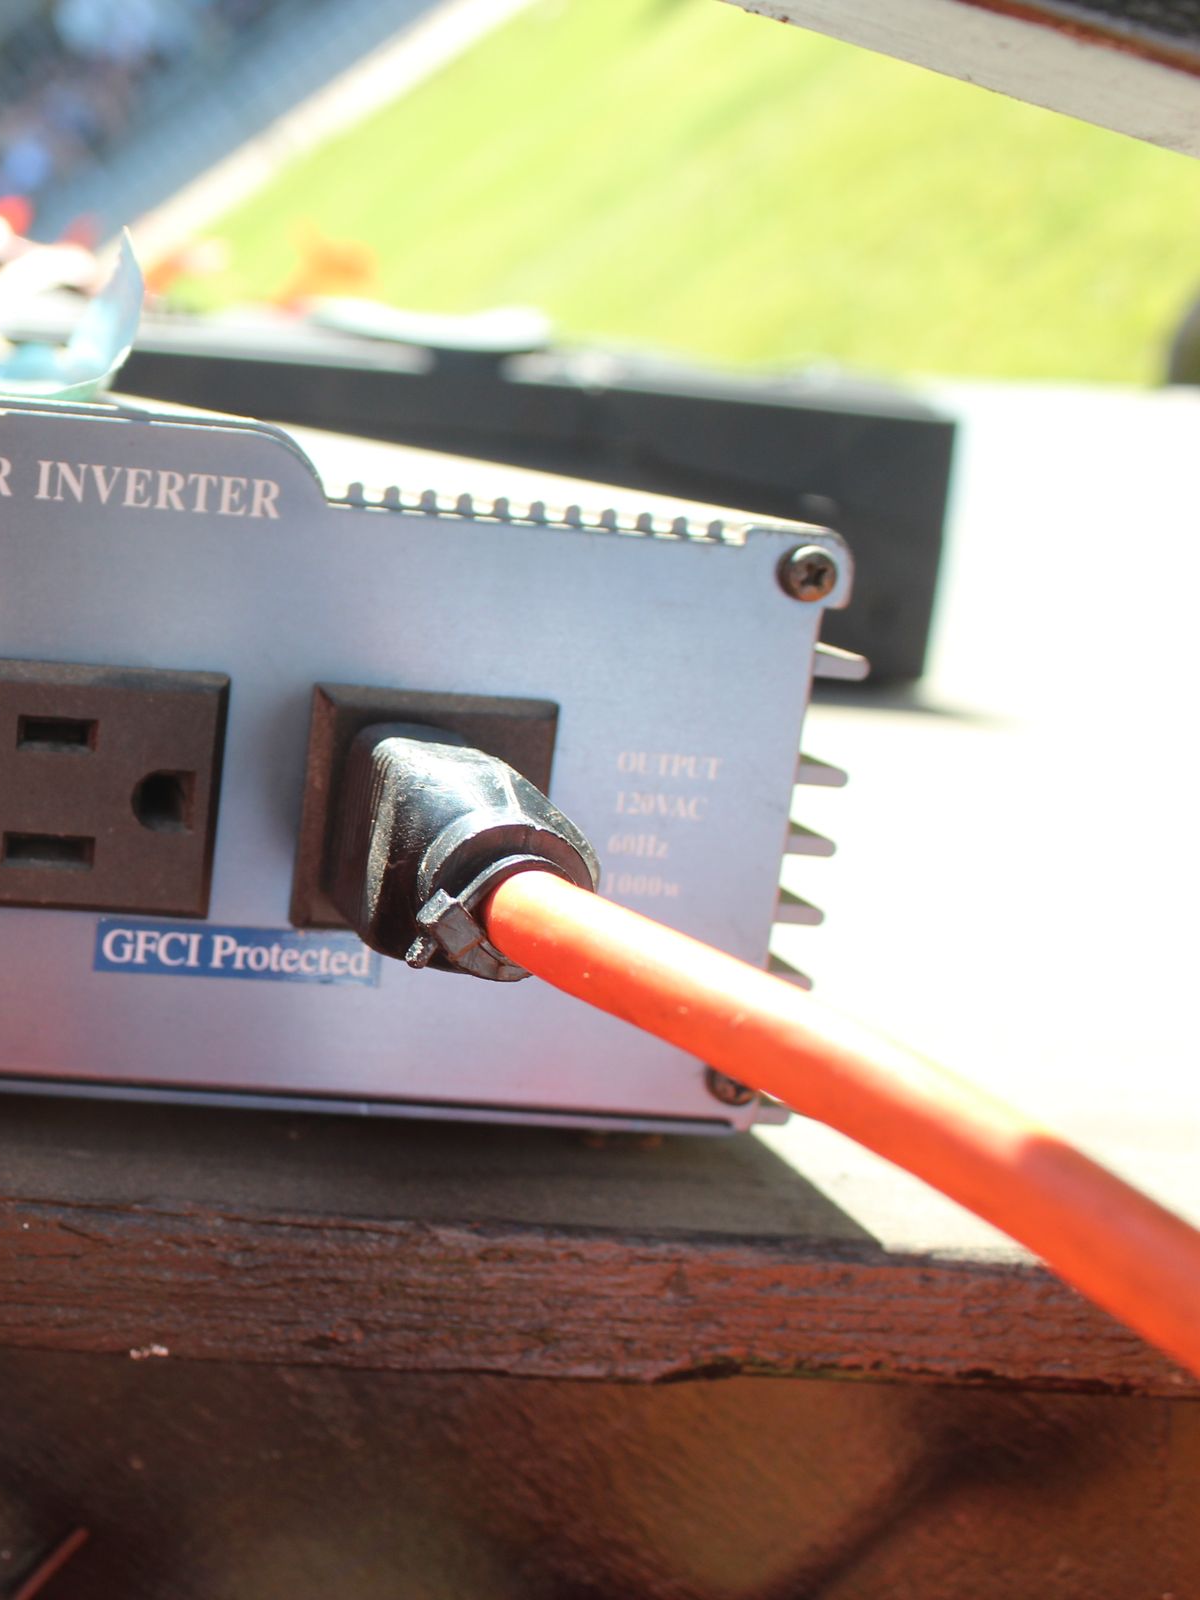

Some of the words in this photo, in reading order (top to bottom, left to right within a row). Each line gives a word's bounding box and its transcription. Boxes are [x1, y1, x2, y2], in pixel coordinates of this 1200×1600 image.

[34, 459, 281, 520] INVERTER
[616, 751, 722, 781] OUTPUT
[615, 790, 706, 820] 120VAC
[607, 833, 669, 859] 60Hz
[102, 929, 202, 967] GFCI
[210, 934, 371, 976] Protected
